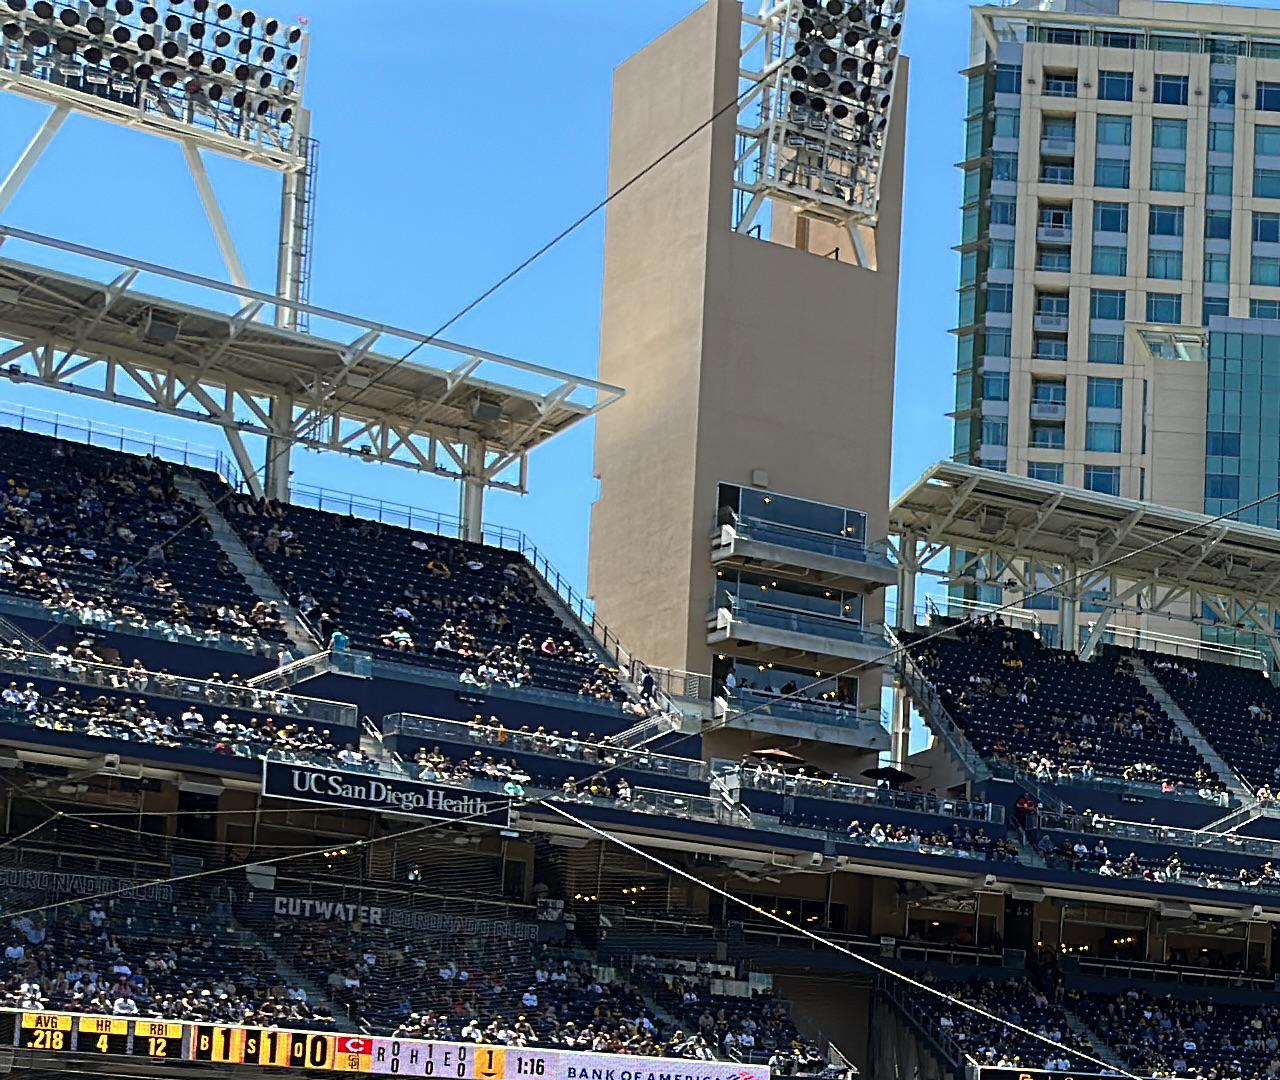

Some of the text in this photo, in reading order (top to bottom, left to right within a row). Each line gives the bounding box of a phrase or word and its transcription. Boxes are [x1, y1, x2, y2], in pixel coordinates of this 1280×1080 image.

[292, 769, 488, 816] UC San Diego Health
[275, 897, 382, 925] CUTWATER
[35, 1016, 168, 1036] AVG HR RBI
[27, 1030, 166, 1057] .218 4 12
[221, 1029, 328, 1066] 1 1 0
[377, 1046, 545, 1075] R H E 1:16
[567, 1067, 615, 1080] BANK
